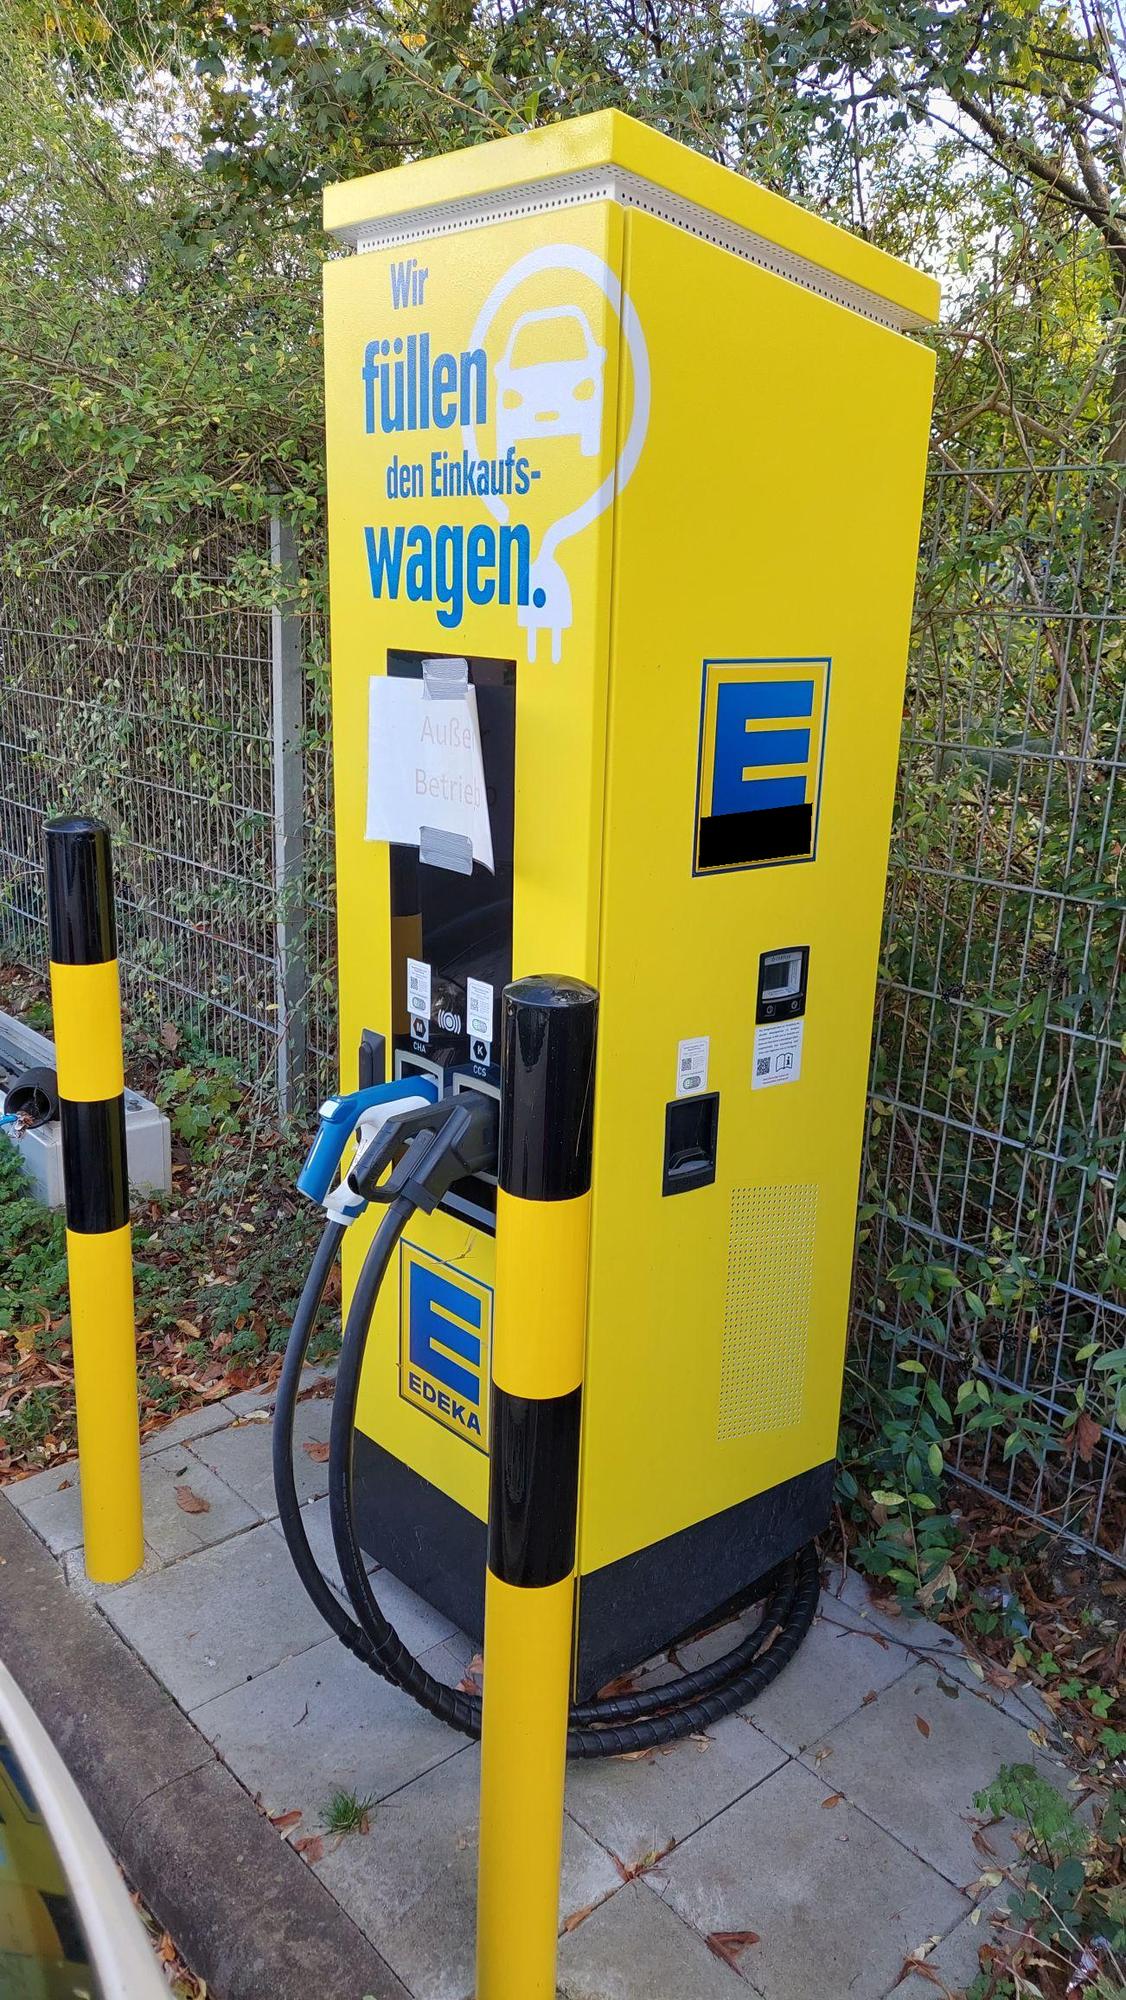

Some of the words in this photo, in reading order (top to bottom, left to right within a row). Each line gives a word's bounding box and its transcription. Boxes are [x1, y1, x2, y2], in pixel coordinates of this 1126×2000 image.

[390, 258, 429, 310] Wir
[362, 333, 486, 434] füllen
[386, 454, 424, 500] den
[430, 446, 542, 498] Einkaufs-
[364, 523, 546, 629] wagen.
[413, 1041, 426, 1053] CHA
[473, 1065, 487, 1077] CCS
[476, 1044, 484, 1056] K
[409, 1372, 481, 1435] EDEKA
